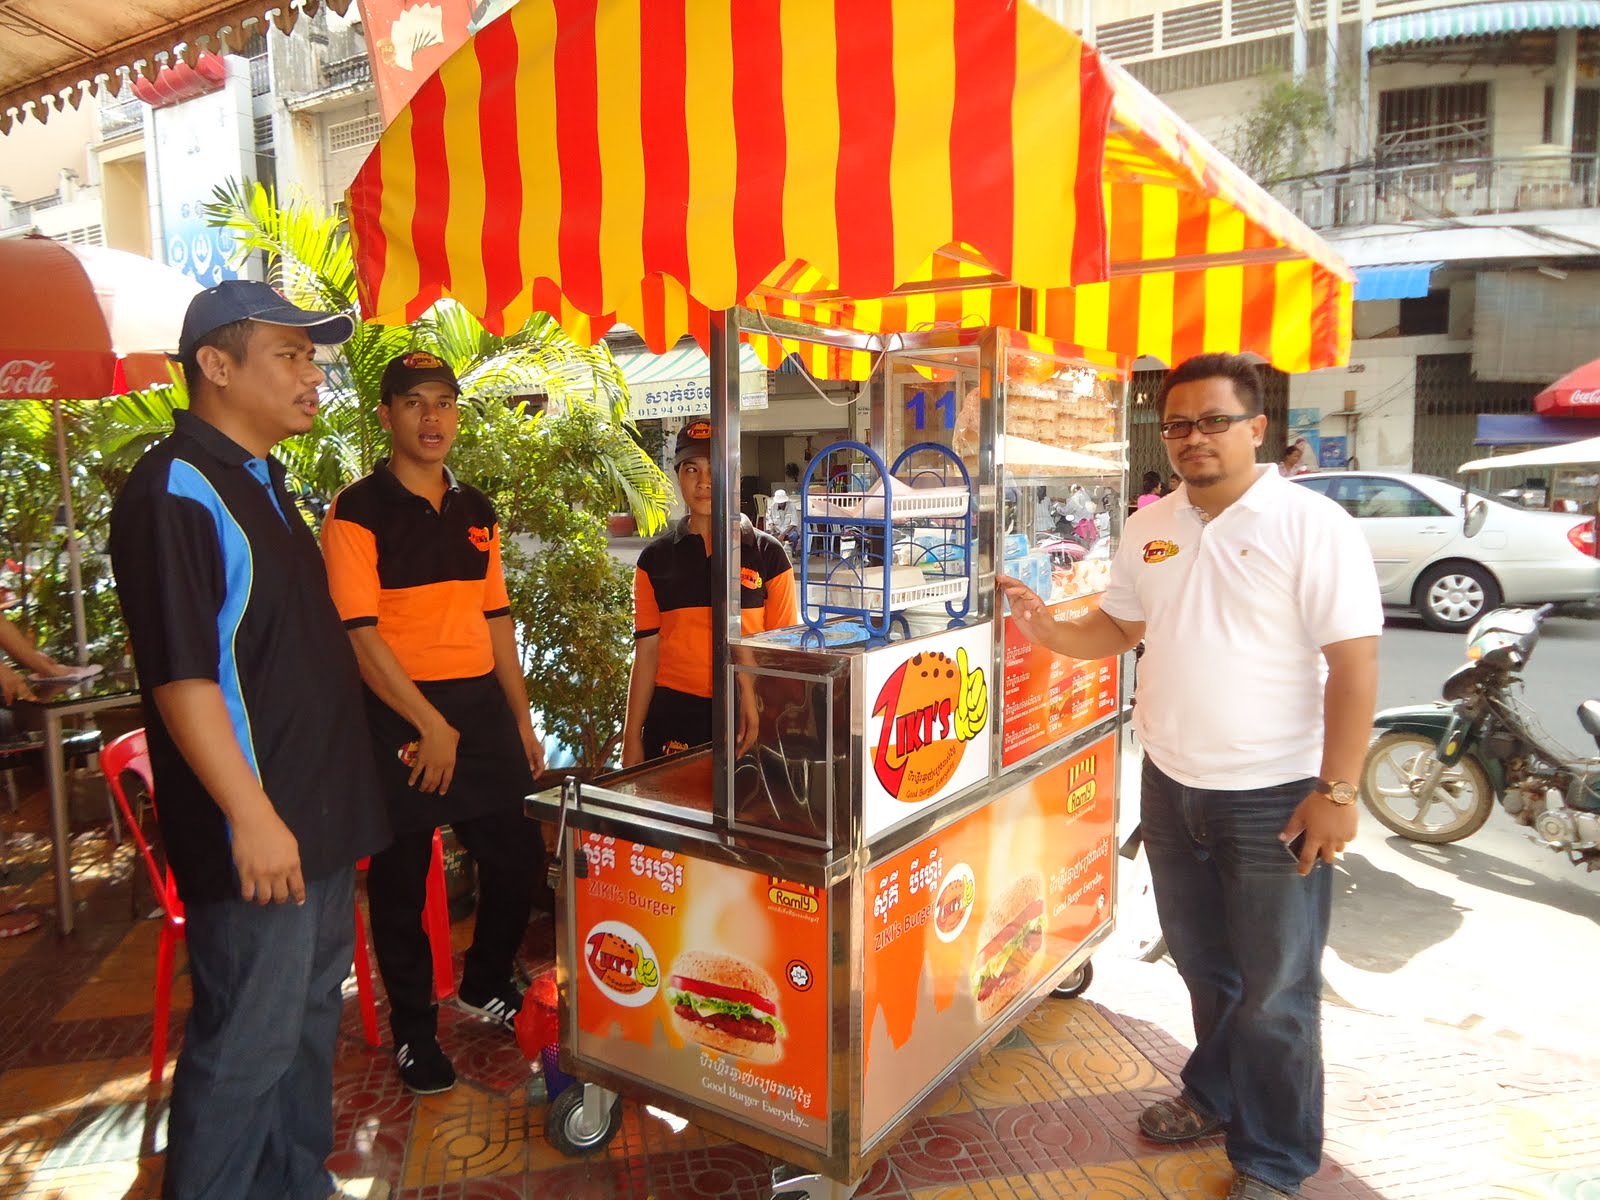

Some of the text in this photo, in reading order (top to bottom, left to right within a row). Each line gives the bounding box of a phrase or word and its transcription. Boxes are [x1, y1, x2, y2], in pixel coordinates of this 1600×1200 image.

[638, 407, 658, 416] 012
[661, 405, 673, 415] 94
[677, 404, 691, 413] 94
[906, 790, 918, 798] Good
[628, 889, 676, 917] Burger
[1053, 895, 1067, 917] Good
[1067, 887, 1083, 905] Burger
[874, 921, 902, 952] ZIKI's
[904, 903, 936, 932] Burger
[702, 1076, 727, 1095] Good
[728, 1085, 760, 1107] Burger
